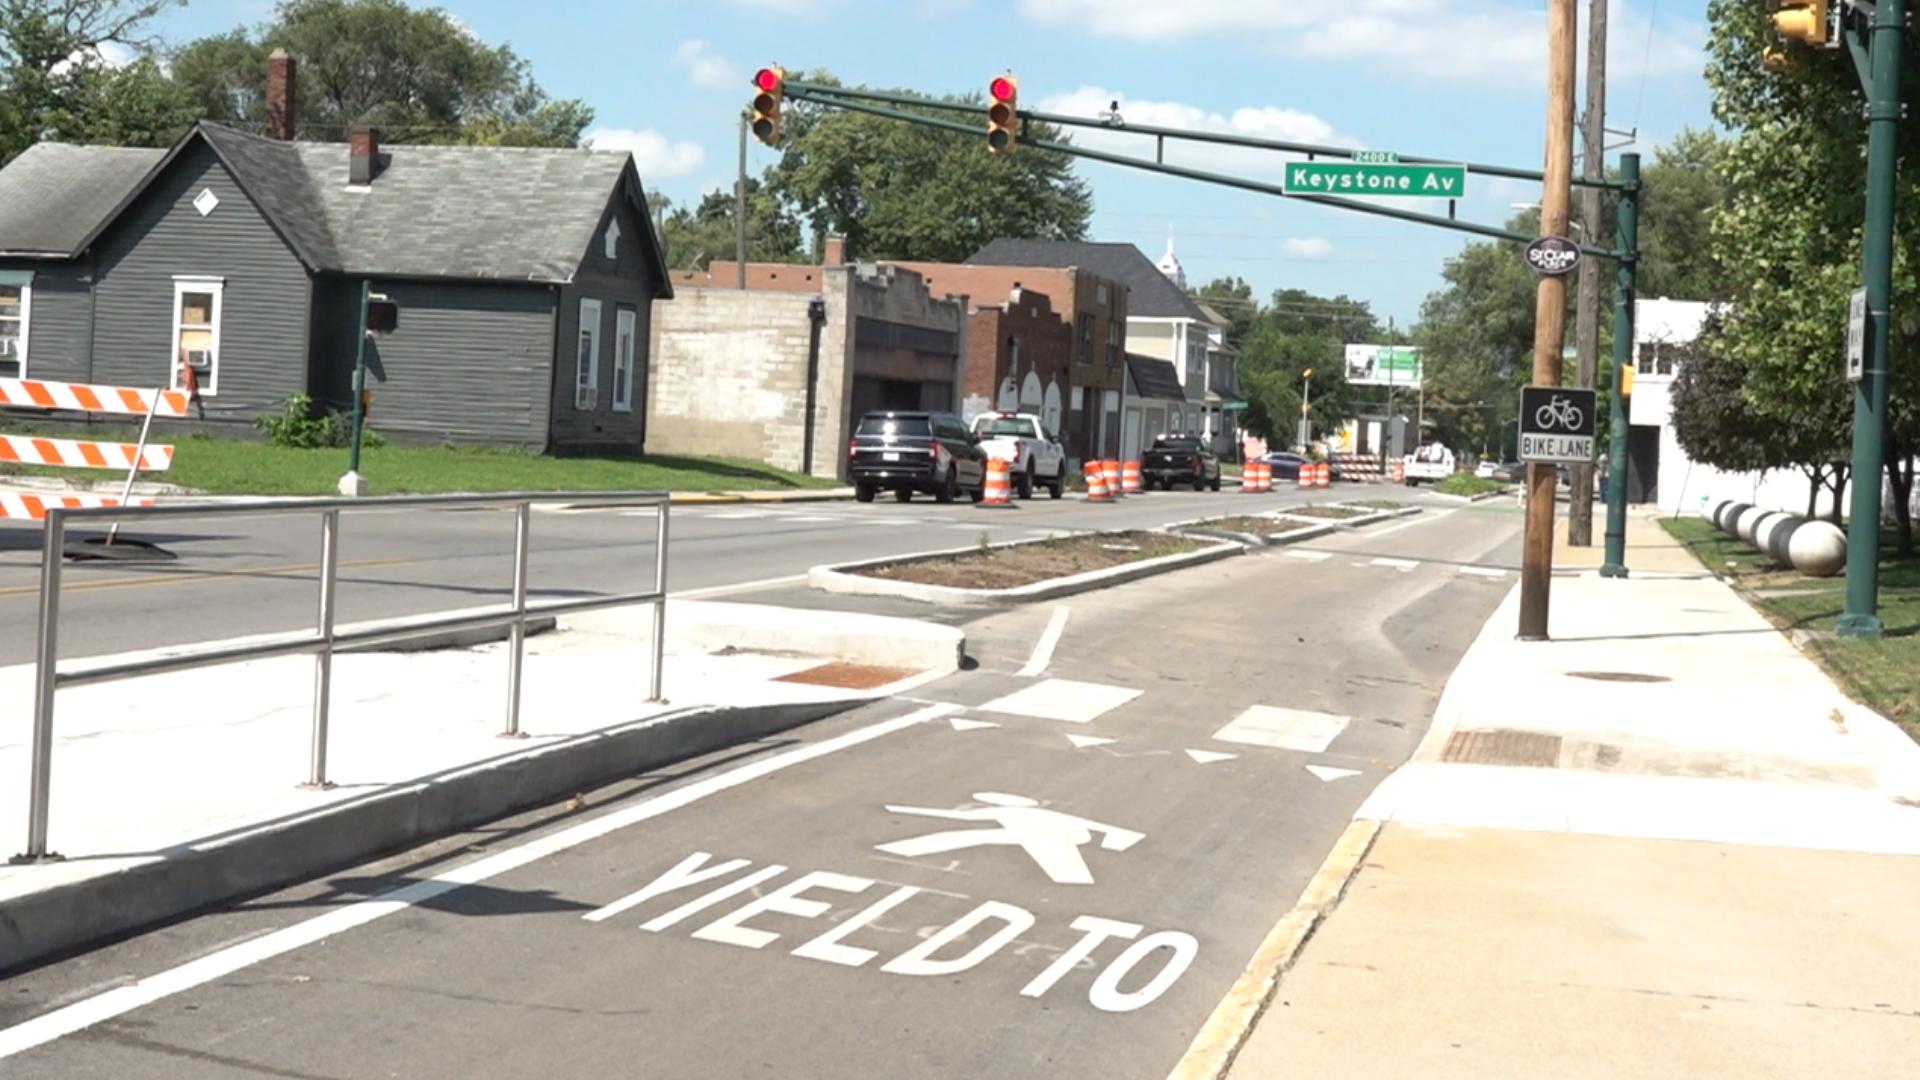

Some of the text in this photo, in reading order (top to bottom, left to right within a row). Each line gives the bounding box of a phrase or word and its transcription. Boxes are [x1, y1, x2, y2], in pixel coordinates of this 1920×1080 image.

[1294, 169, 1456, 191] Keystone Av
[1523, 437, 1591, 458] BIKE LANE
[581, 852, 1199, 1012] YIELD TO
